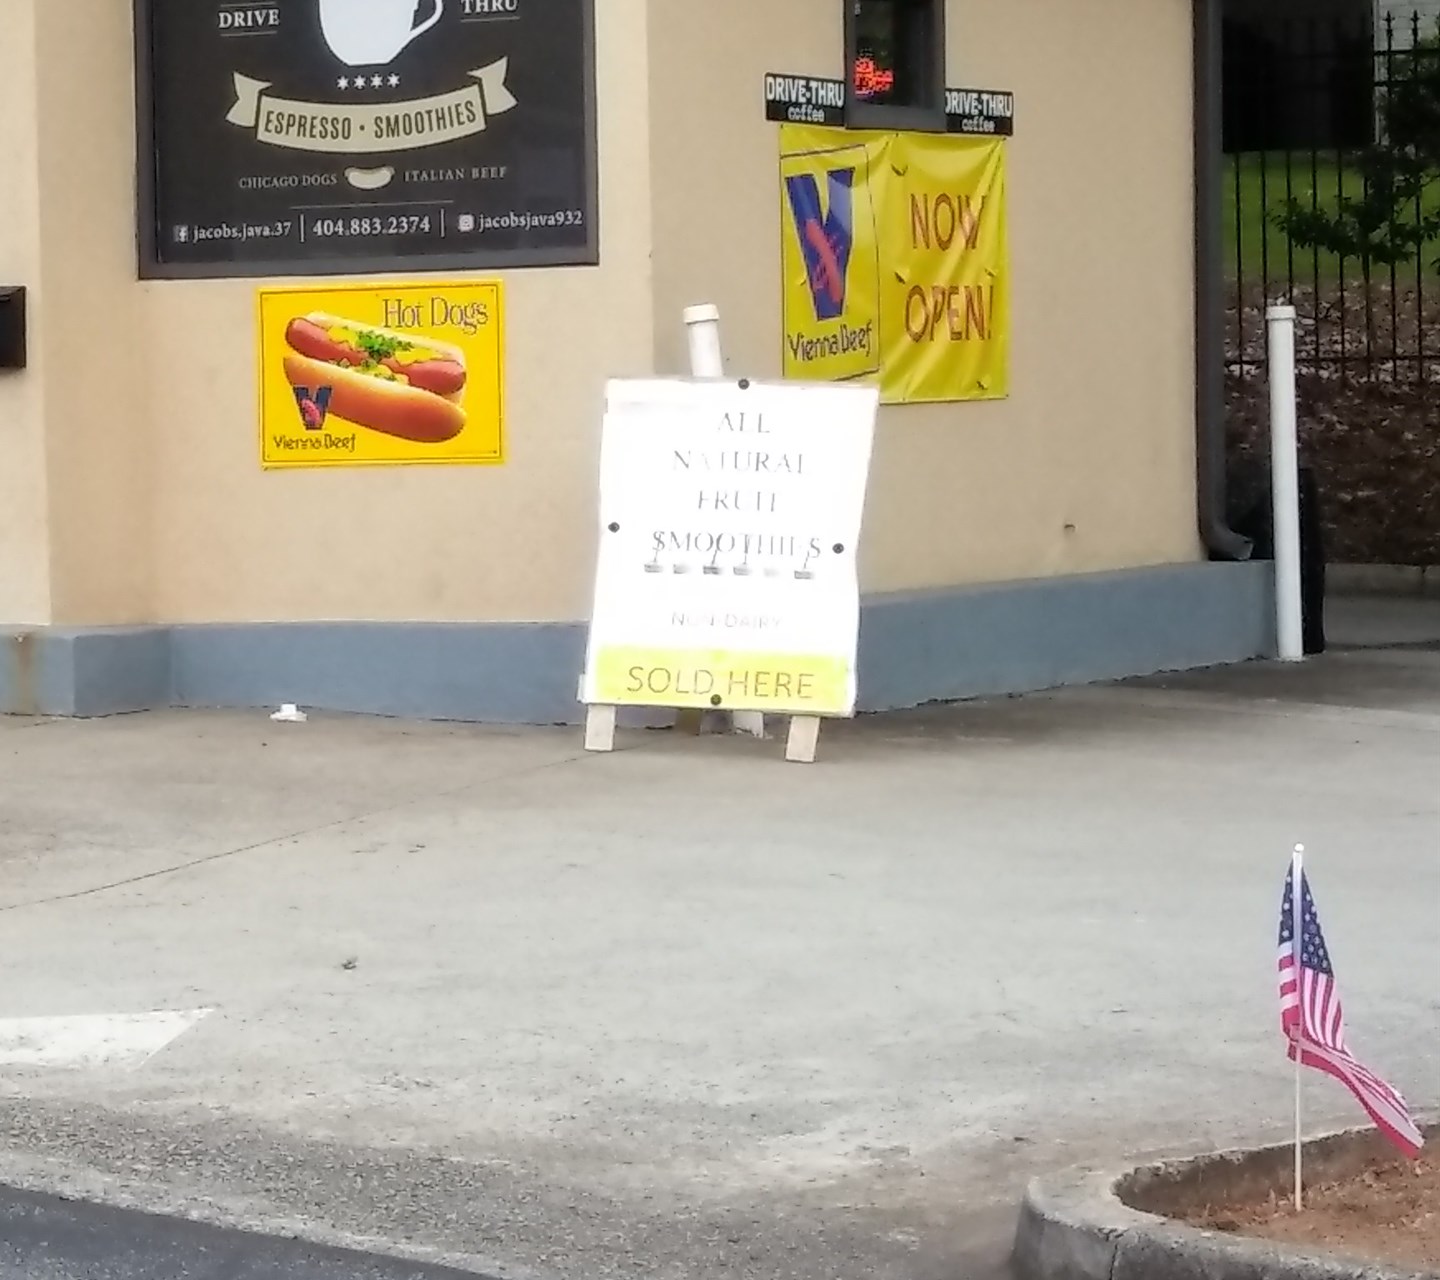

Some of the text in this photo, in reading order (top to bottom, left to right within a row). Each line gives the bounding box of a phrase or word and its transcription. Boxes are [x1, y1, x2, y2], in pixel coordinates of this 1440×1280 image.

[218, 8, 281, 30] DRIVE
[766, 76, 845, 108] DRIVE-THRU
[264, 100, 477, 141] ESPRESSO SMOOTHIES
[787, 104, 826, 123] coffee
[961, 117, 996, 133] coffee
[238, 166, 508, 190] CHICAGO DOGS ITALIAN BEEF
[311, 215, 432, 239] 404.883.2374
[477, 208, 584, 233] jacobsjava932
[910, 192, 988, 252] NOW
[382, 295, 489, 336] Hot Dogs
[904, 283, 994, 344] OPEN!
[787, 318, 873, 362] Vienna Beef
[716, 411, 771, 434] ALL
[273, 433, 357, 453] Vienna Beef
[626, 665, 815, 699] SOLD HERE
